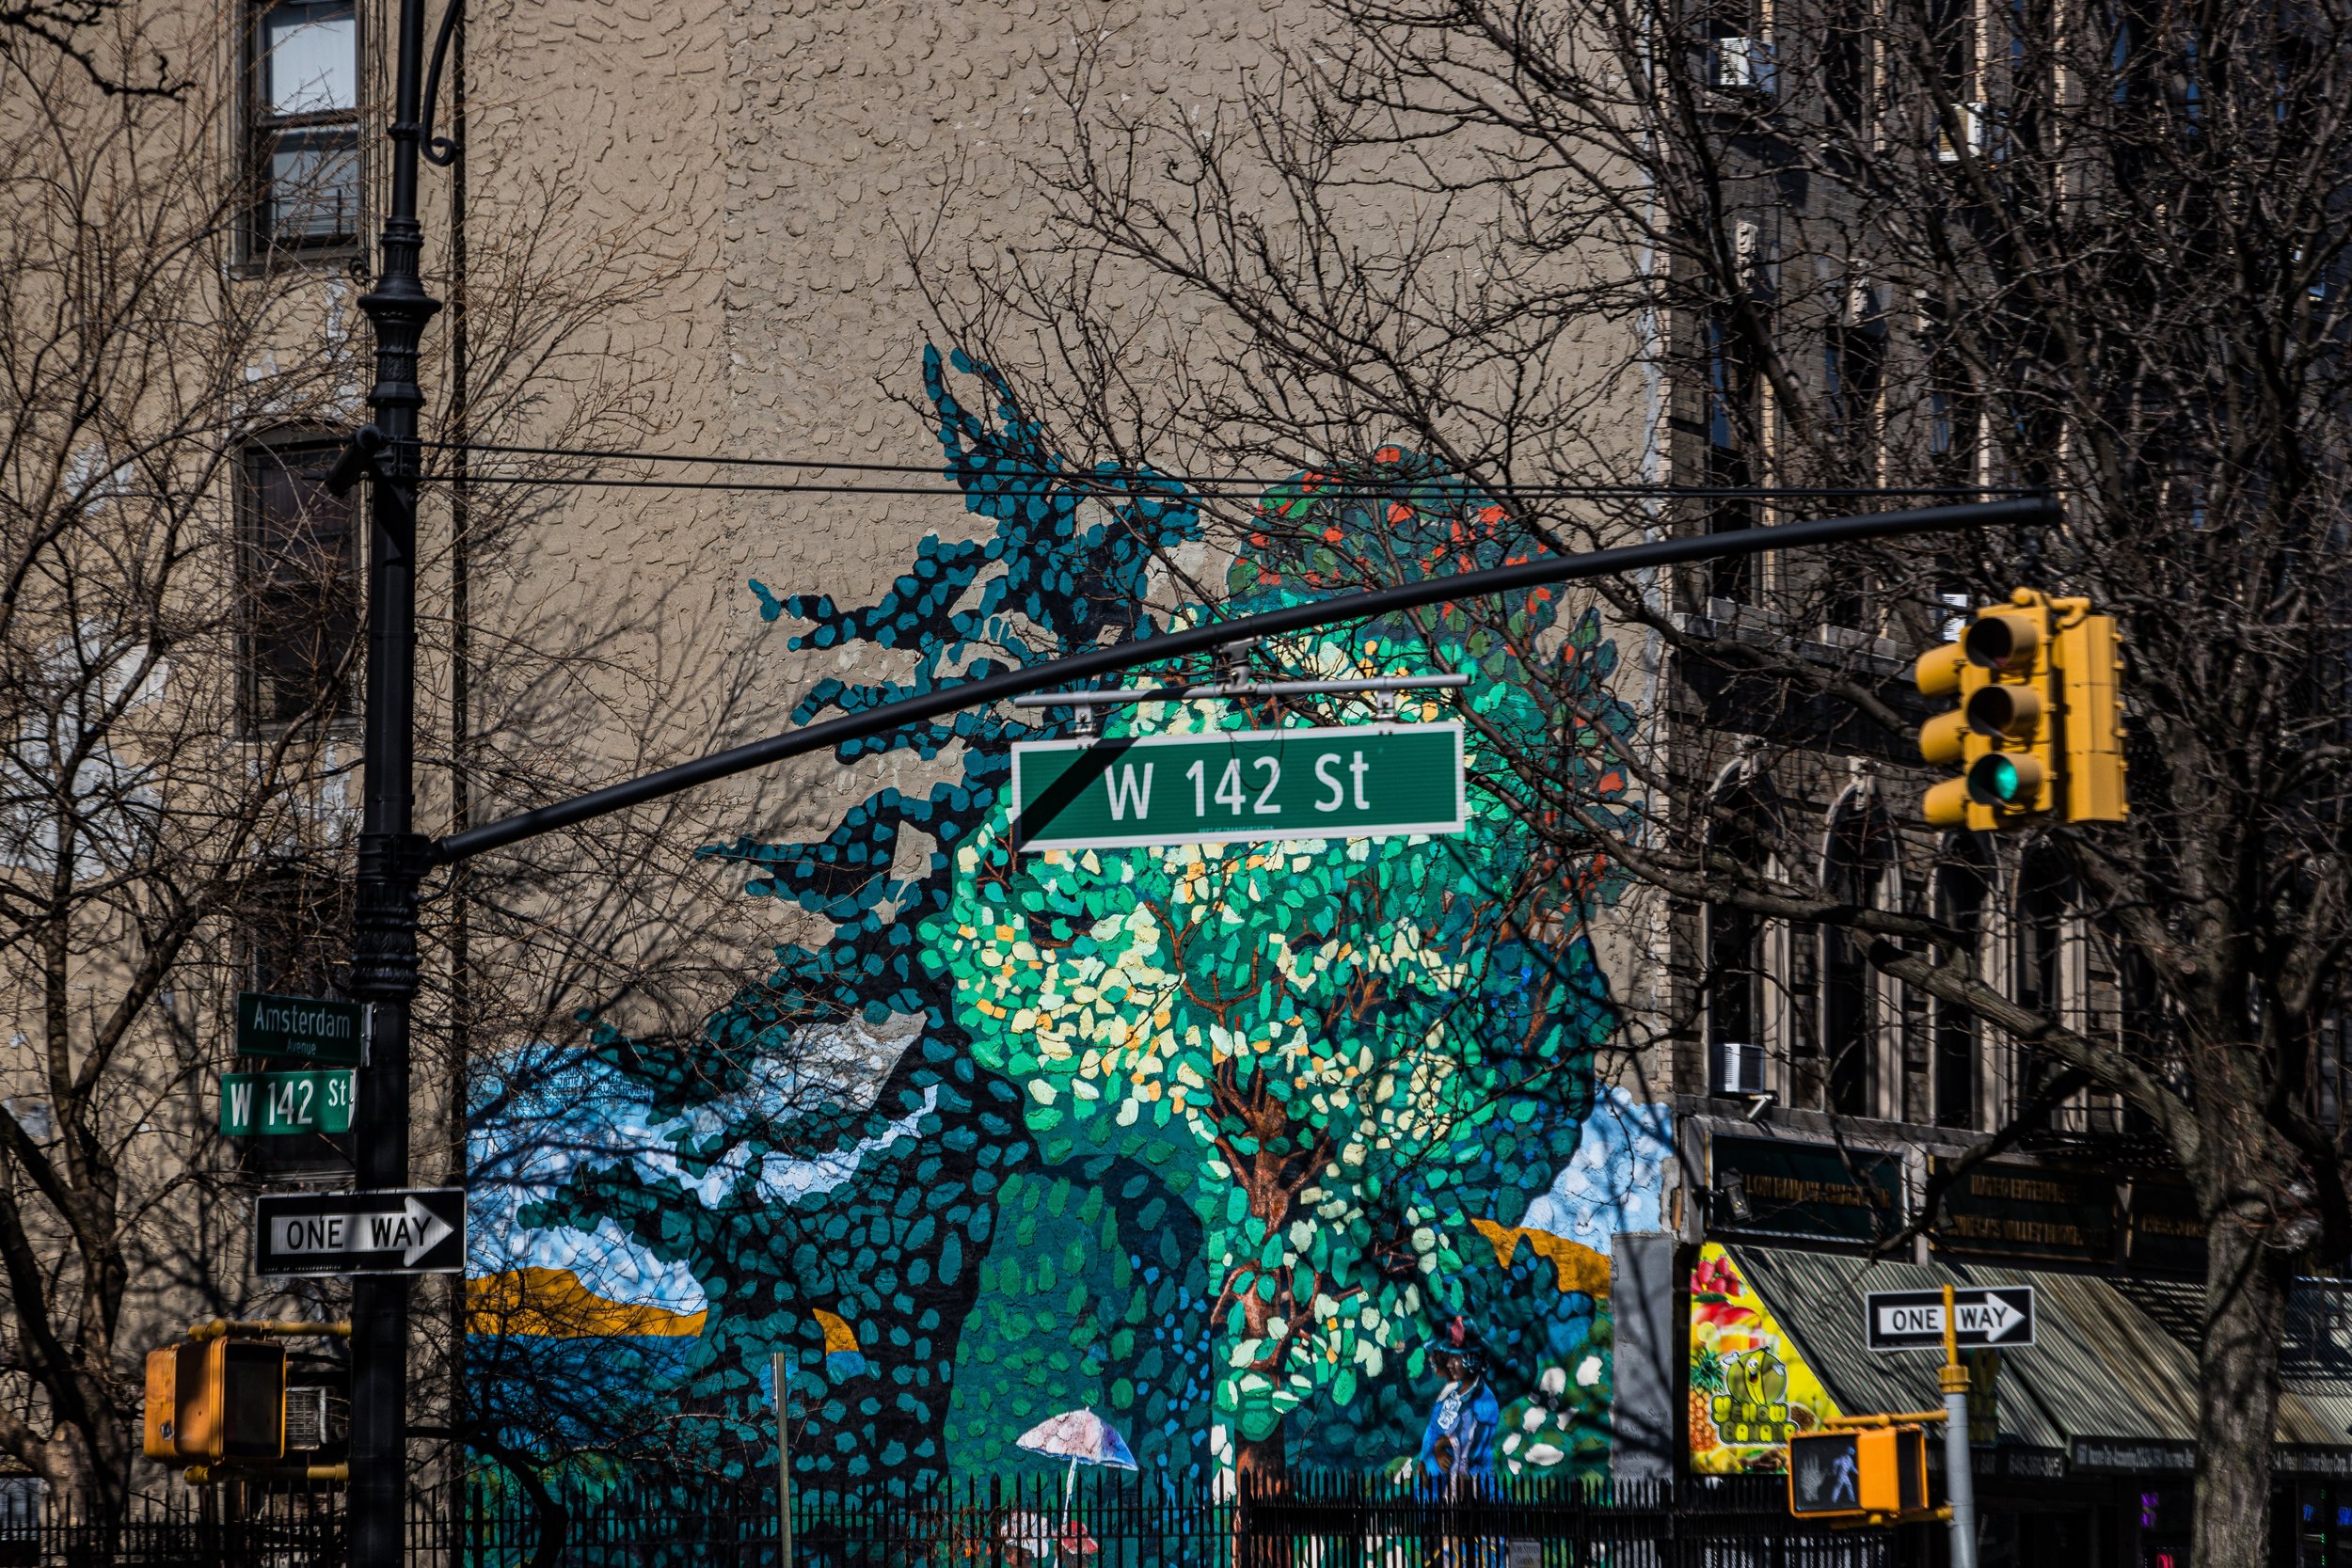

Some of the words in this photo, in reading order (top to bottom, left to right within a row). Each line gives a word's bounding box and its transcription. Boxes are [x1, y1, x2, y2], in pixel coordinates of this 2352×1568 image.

[1104, 762, 1154, 821] W
[1185, 755, 1281, 817] 142
[1314, 751, 1371, 813] St
[253, 1001, 351, 1038] Amsterdam
[286, 1038, 317, 1055] Avenue
[230, 1083, 253, 1127] W
[268, 1079, 314, 1126] 142
[328, 1078, 346, 1107] St
[287, 1218, 343, 1250] ONE
[371, 1215, 434, 1248] WAY
[1892, 1308, 1939, 1331] ONE
[1960, 1307, 2008, 1329] WAY
